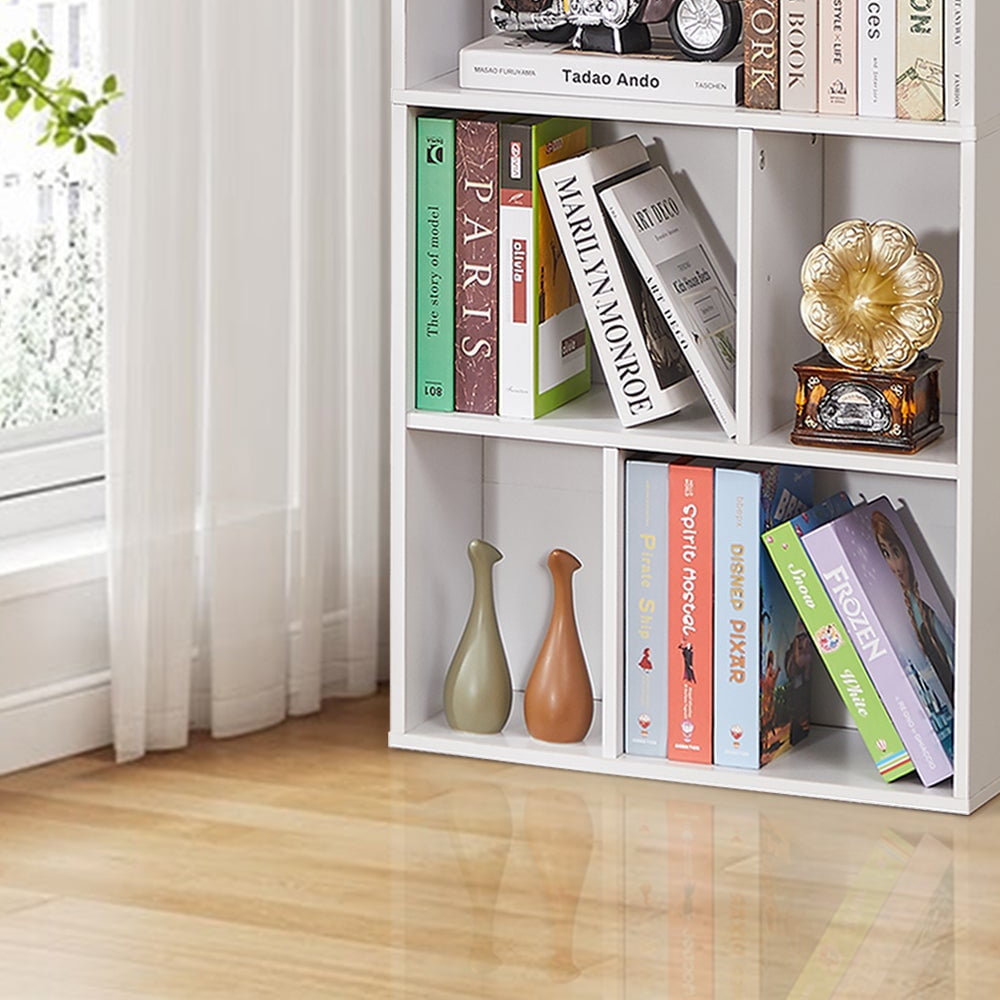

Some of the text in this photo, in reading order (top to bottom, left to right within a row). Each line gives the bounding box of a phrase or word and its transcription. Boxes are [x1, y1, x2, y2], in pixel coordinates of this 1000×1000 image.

[832, 0, 842, 33] STYLE
[474, 66, 498, 75] MASAO
[788, 11, 806, 90] BOOK
[832, 44, 842, 65] LIFE
[562, 68, 660, 89] Tadao Ando
[694, 81, 727, 90] TASCHEN
[651, 196, 680, 223] DECO
[427, 206, 443, 337] The story of model
[461, 178, 494, 359] PARIS
[554, 174, 654, 416] MARILYN MONROE
[424, 385, 443, 397] 801
[639, 534, 656, 640] Pirate Ship
[681, 567, 697, 636] Hostel
[787, 563, 816, 609] Snow
[823, 564, 888, 663] FROZEN
[729, 619, 746, 685] PIXAR
[840, 668, 868, 718] White
